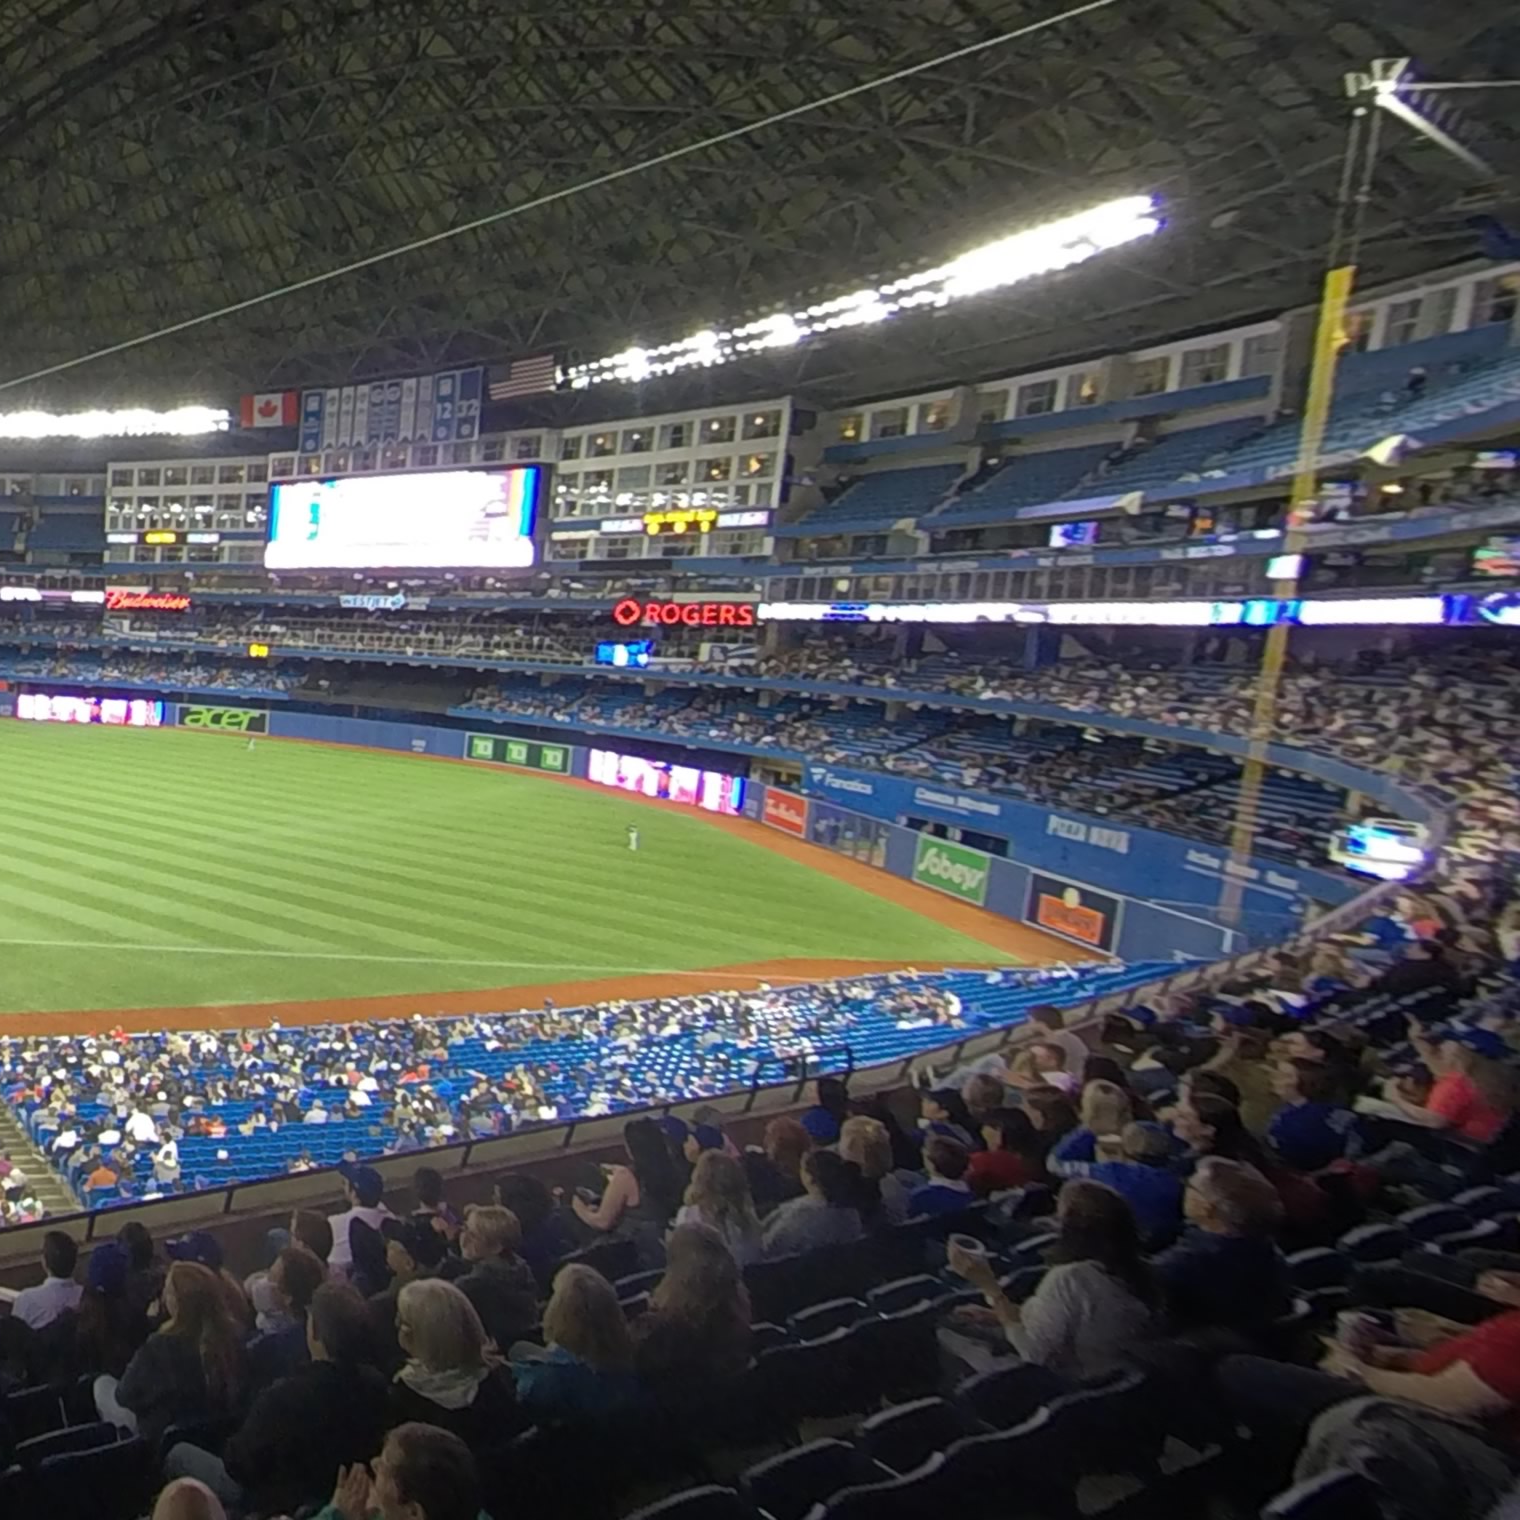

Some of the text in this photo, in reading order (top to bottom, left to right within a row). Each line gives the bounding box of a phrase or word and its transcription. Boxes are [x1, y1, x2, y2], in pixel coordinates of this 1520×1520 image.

[436, 402, 453, 420] 12
[106, 588, 191, 609] Budweiser
[645, 603, 753, 626] ROGERS
[184, 706, 260, 733] acer
